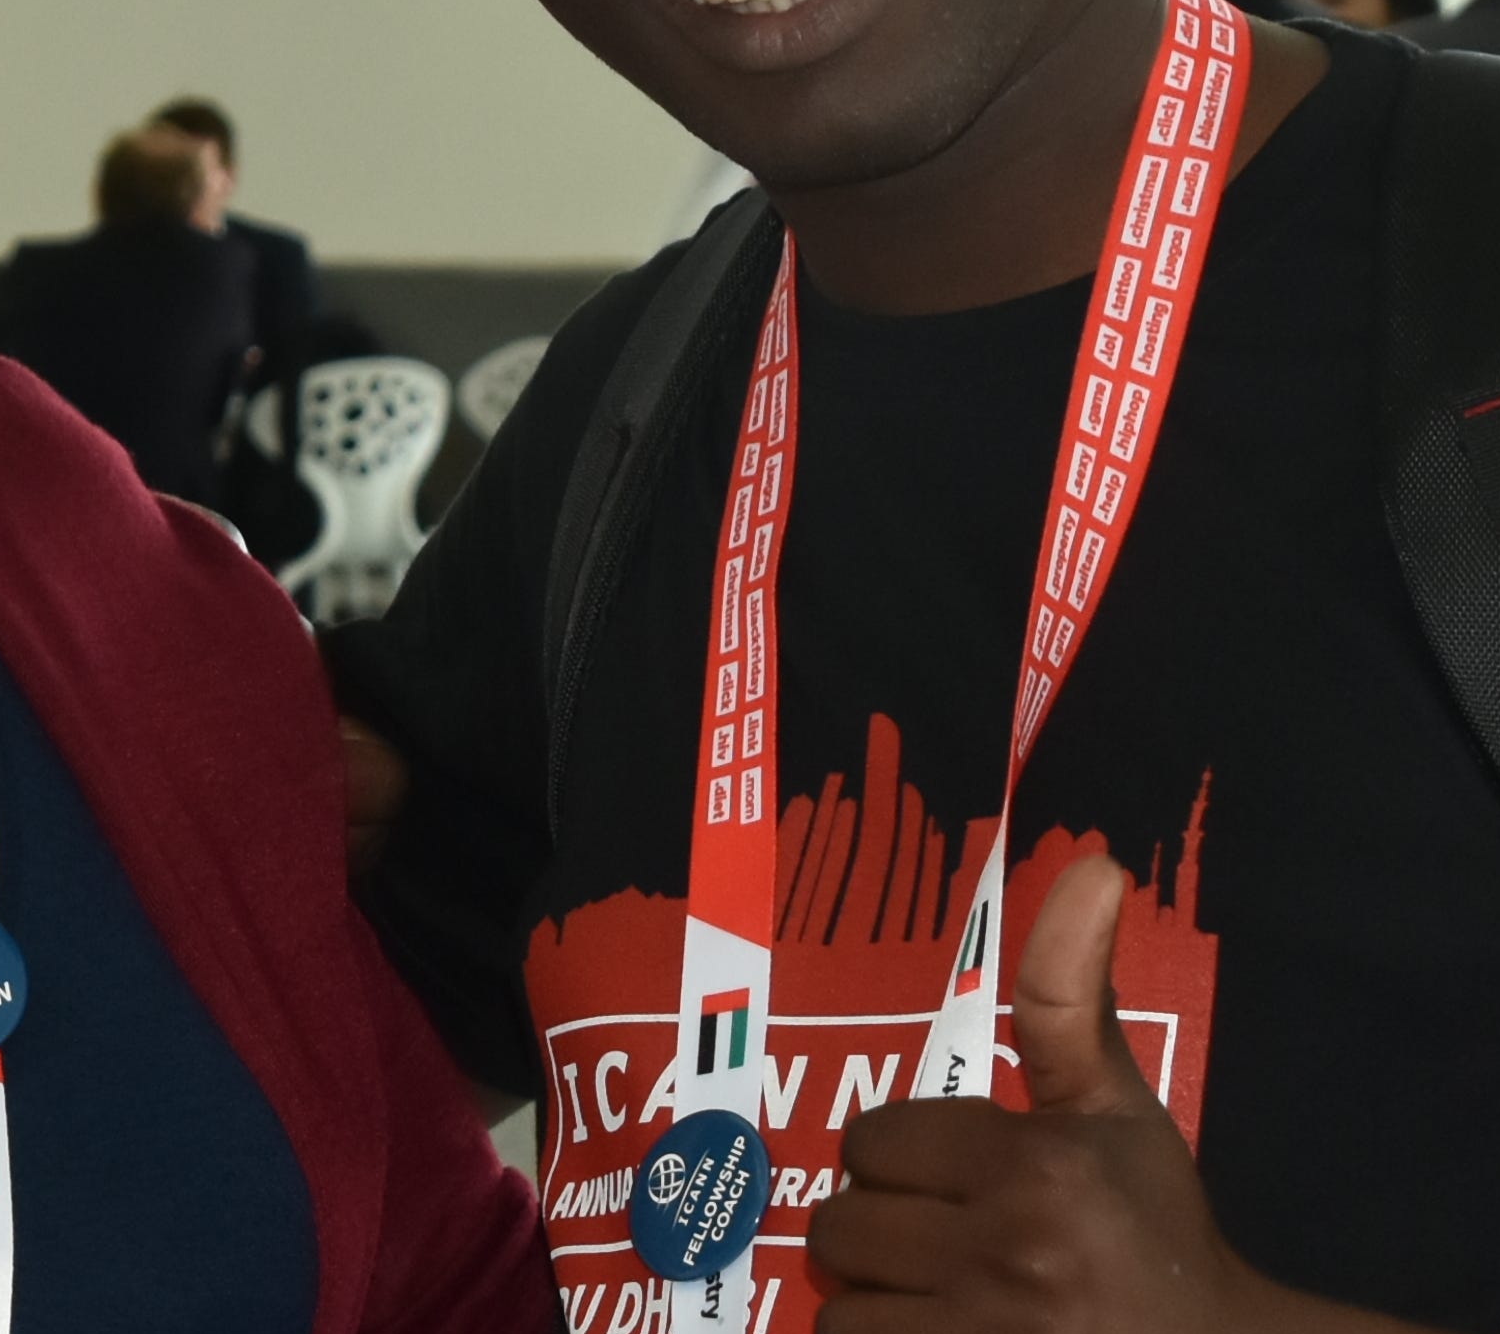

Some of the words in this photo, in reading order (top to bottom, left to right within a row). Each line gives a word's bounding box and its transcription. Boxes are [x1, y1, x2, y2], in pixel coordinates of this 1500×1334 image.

[1157, 99, 1178, 142] .click
[1196, 64, 1229, 145] .blackfriday
[1131, 161, 1162, 244] .christmas
[1182, 163, 1203, 212] .audio
[1160, 230, 1185, 285] .juegos
[1112, 261, 1135, 317] .tattoo
[1100, 332, 1118, 363] .lol
[1139, 302, 1169, 371] .hosting
[1088, 381, 1107, 432] .game
[1117, 388, 1145, 456] .hiphop
[1075, 448, 1094, 496] .sexy
[1099, 473, 1122, 520] .help
[1052, 512, 1077, 595] .property
[1076, 537, 1101, 607] .guitars
[724, 562, 740, 648] .christmas
[747, 595, 763, 697] .blackfriday
[720, 668, 734, 711] .click
[717, 731, 730, 760] .hiv
[746, 716, 760, 753] .link
[713, 782, 727, 820] .diet
[745, 773, 755, 819] .mom
[549, 1164, 640, 1221] ANNUA
[678, 1157, 715, 1226] ICANN
[683, 1135, 746, 1266] FELLOWSHIP
[711, 1170, 750, 1241] COACH
